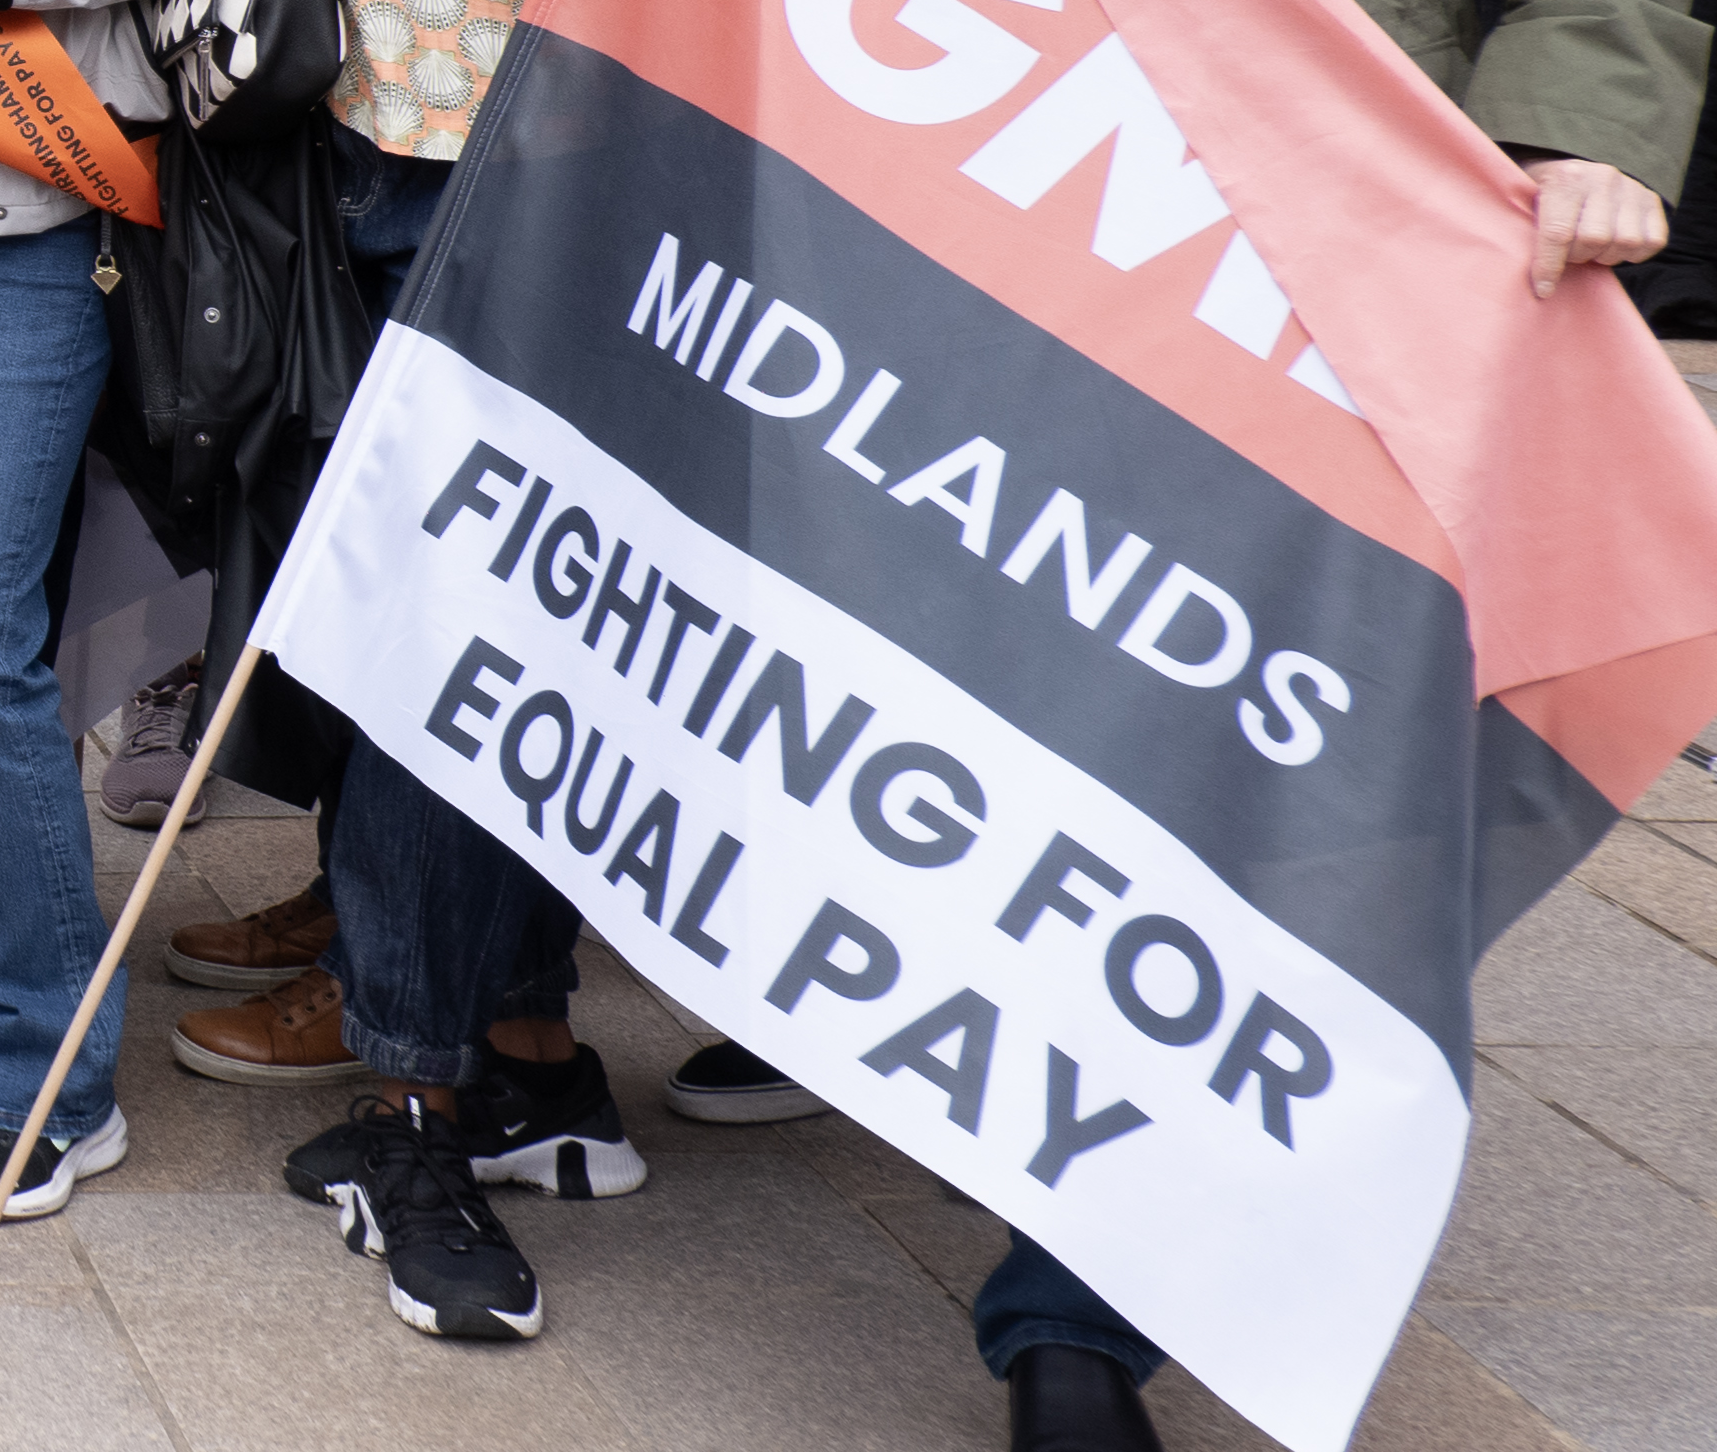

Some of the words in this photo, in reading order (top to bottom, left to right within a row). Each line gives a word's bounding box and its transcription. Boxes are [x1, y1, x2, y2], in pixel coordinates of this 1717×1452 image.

[27, 81, 64, 126] FOR
[627, 231, 1354, 770] MIDLANDS
[421, 439, 988, 871] FIGHTING
[993, 829, 1334, 1153] FOR
[425, 640, 745, 969] EQUAL
[763, 896, 1155, 1193] PAY
